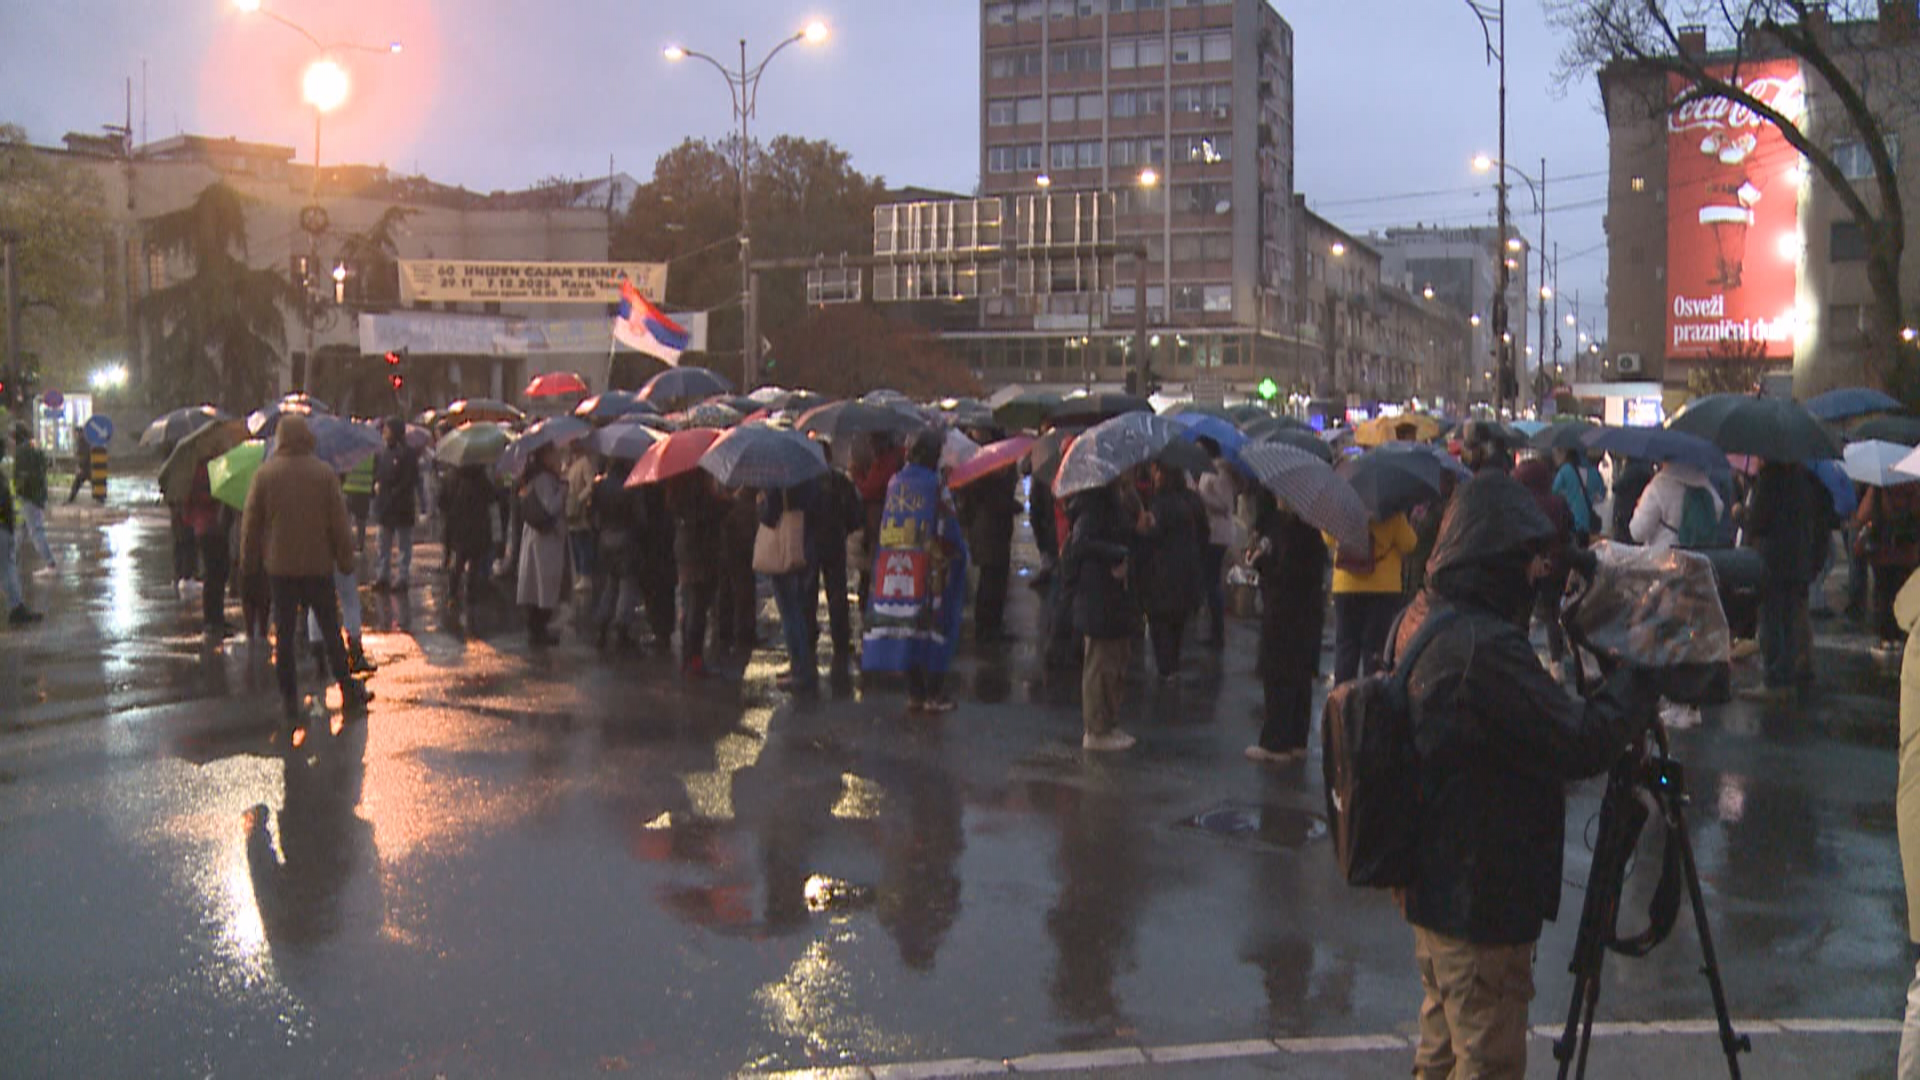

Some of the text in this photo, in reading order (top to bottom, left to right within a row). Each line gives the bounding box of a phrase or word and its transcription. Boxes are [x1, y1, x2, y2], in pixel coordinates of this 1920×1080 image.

[524, 266, 573, 277] САЈАМ
[1674, 294, 1724, 317] Osveži
[1673, 319, 1749, 345] praznični
